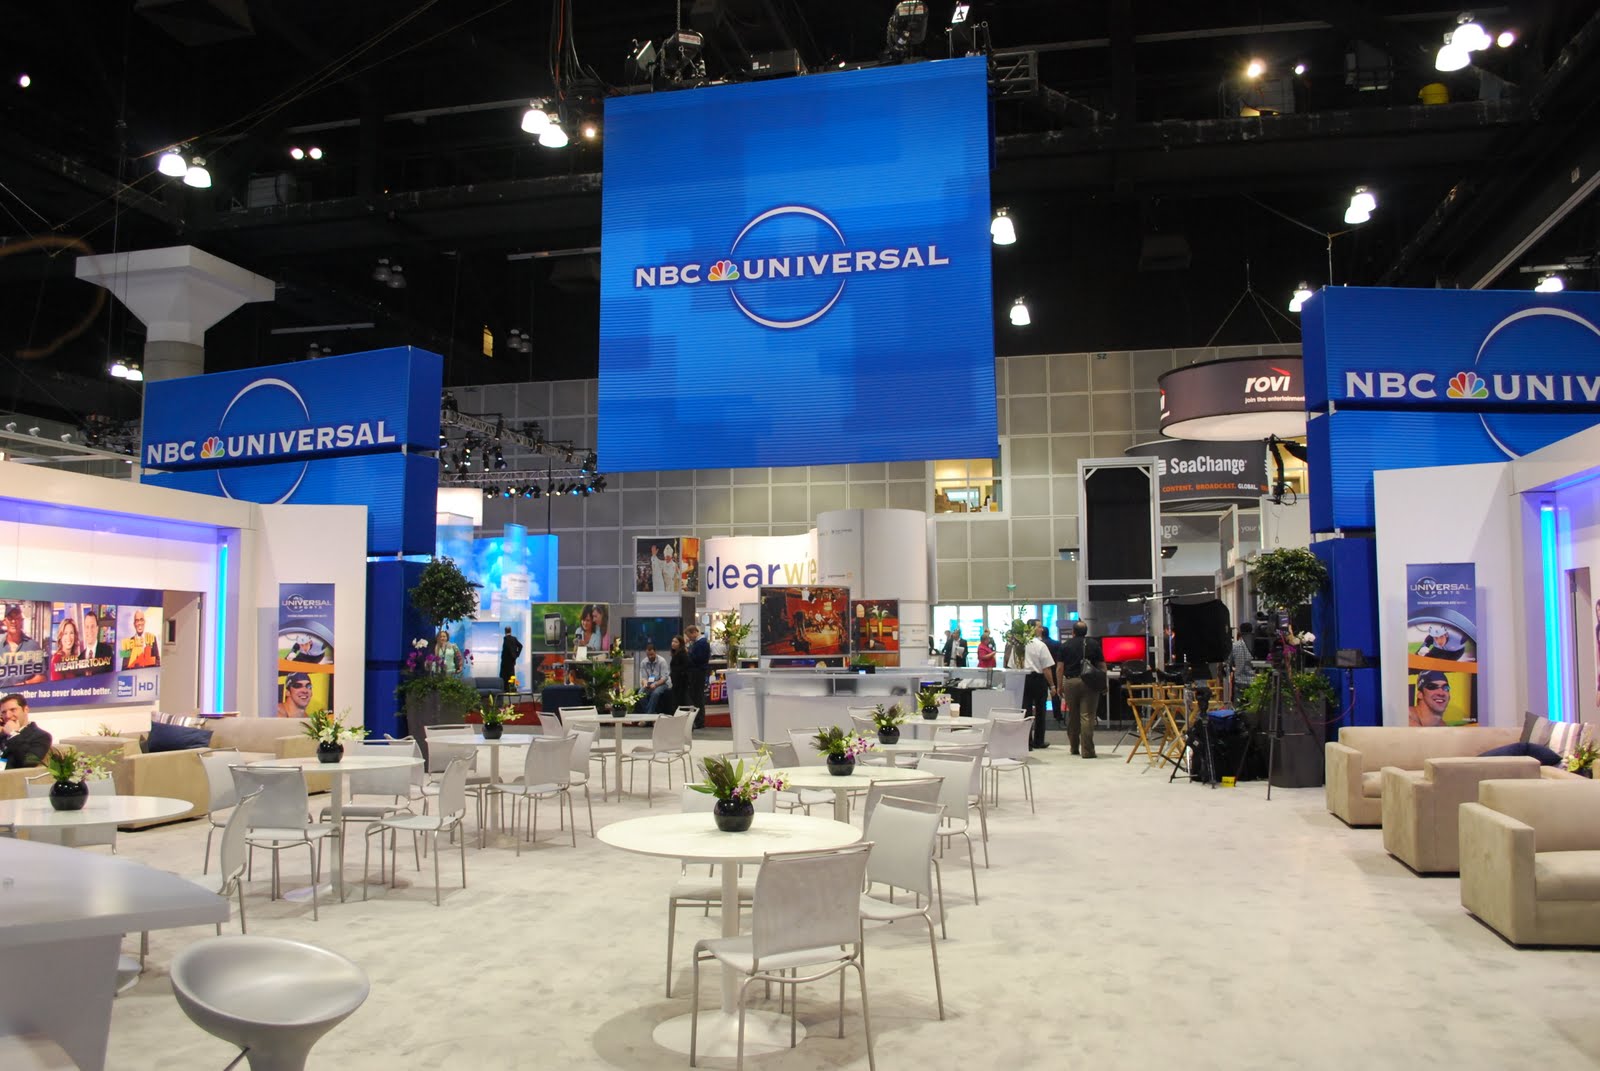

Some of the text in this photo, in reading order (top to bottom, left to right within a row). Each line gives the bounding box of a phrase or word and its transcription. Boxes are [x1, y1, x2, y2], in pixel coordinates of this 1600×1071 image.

[635, 245, 949, 288] NBC UNIVERSAL
[1244, 367, 1291, 393] rovi
[1345, 371, 1438, 399] NBC
[147, 421, 395, 465] NBC UNIVERSAL
[1170, 456, 1245, 475] SeaChange
[1162, 483, 1194, 493] CONTENT.
[1195, 482, 1236, 491] BROADCAST.
[1237, 482, 1259, 490] GLOBAL.
[1241, 526, 1257, 534] your
[706, 554, 817, 590] clearwre
[1410, 583, 1472, 591] UNIVERSAL
[54, 656, 112, 672] WEATHER TODAY
[38, 690, 51, 698] has
[71, 688, 92, 696] looked
[138, 682, 154, 691] HD
